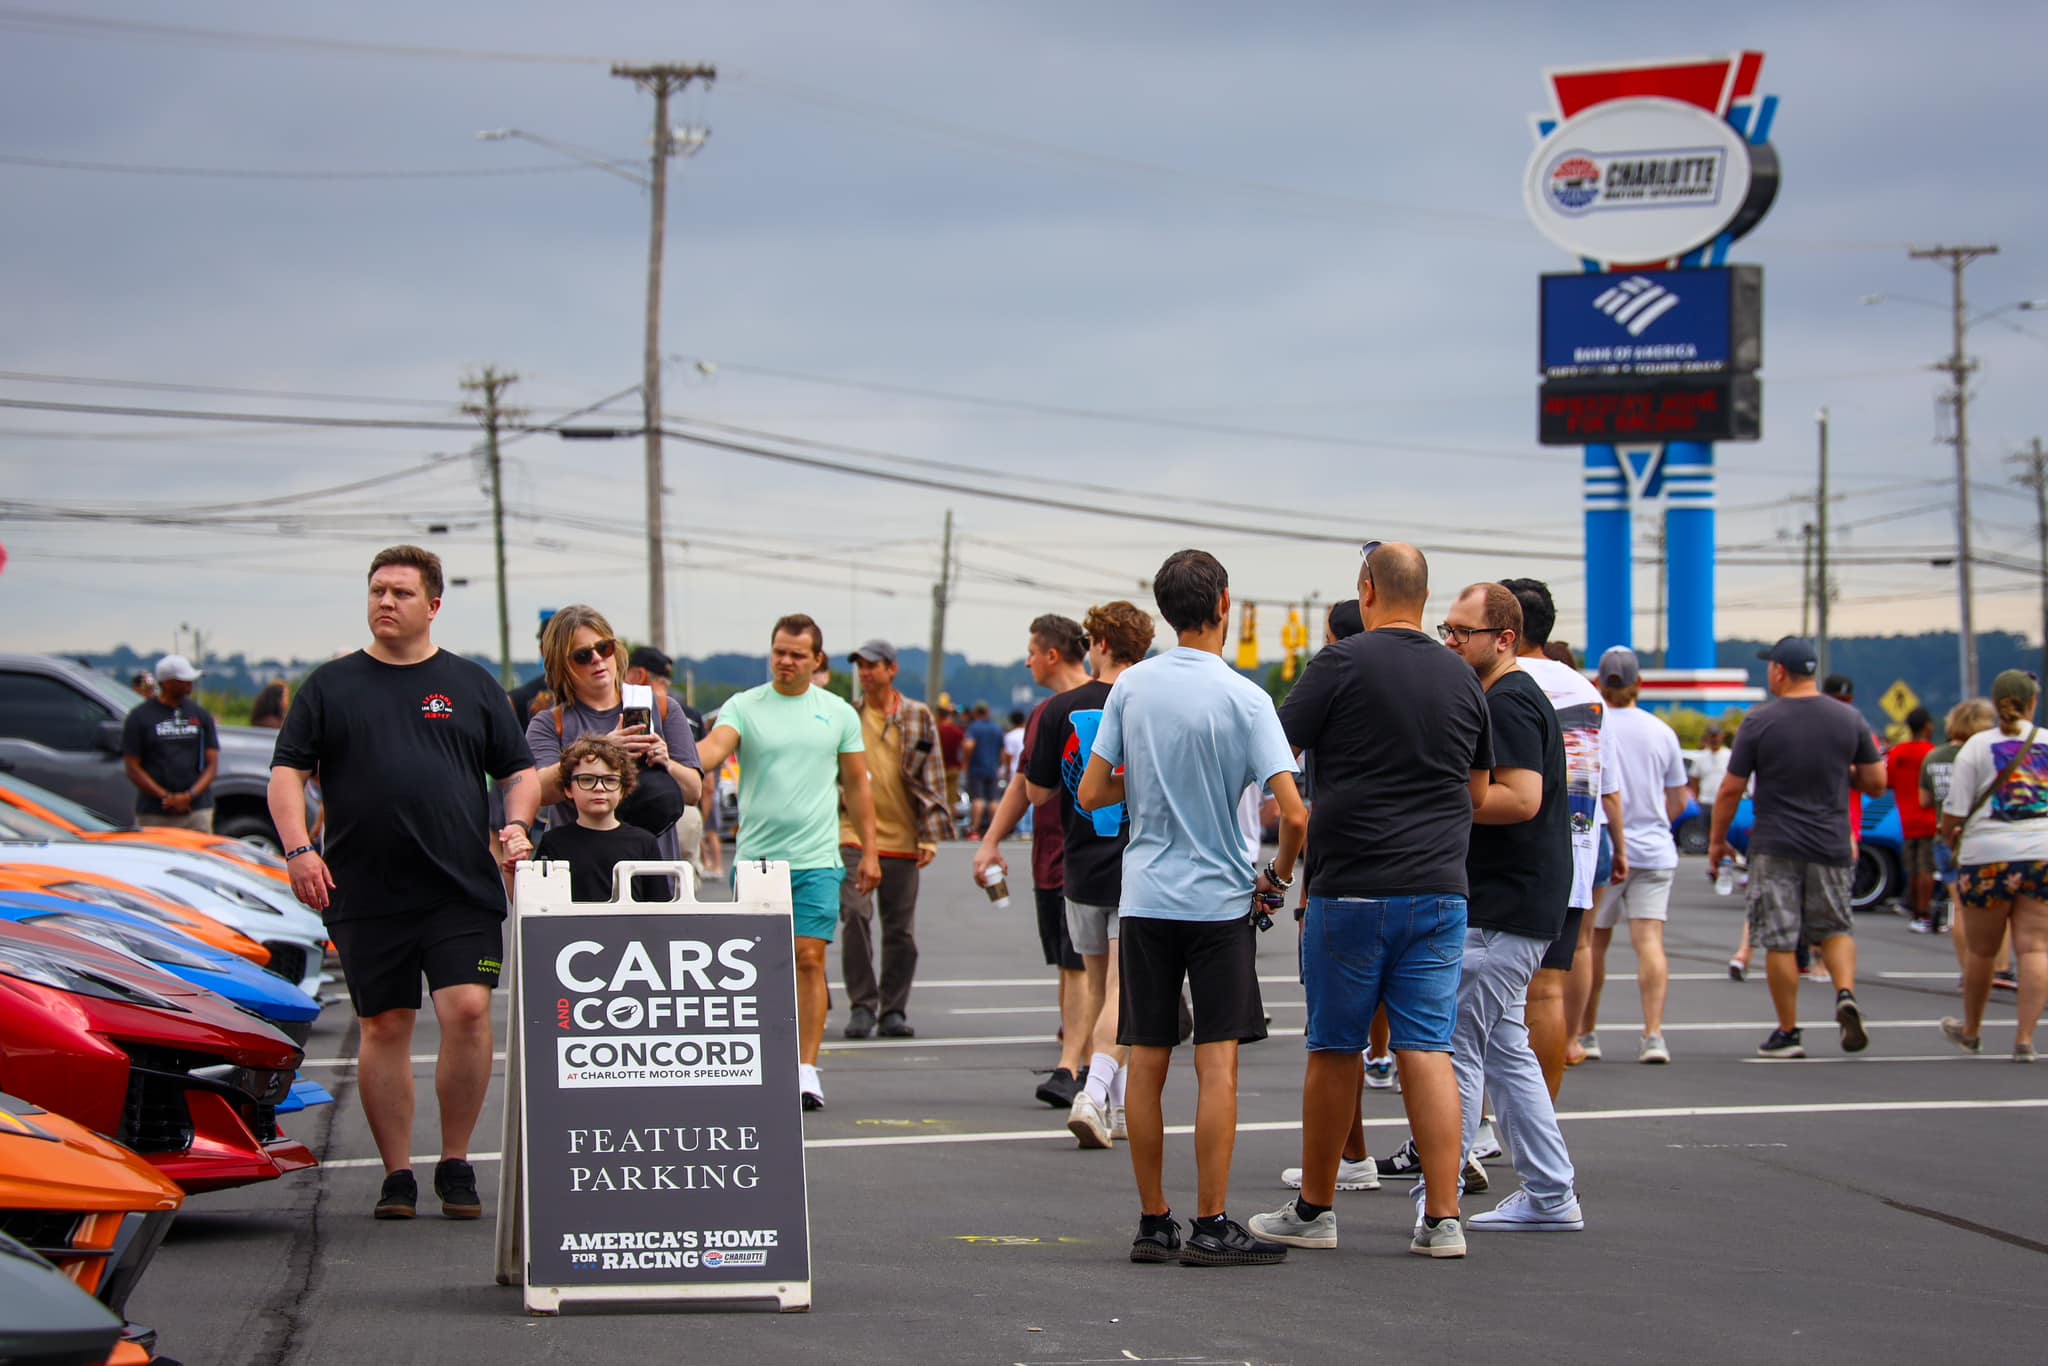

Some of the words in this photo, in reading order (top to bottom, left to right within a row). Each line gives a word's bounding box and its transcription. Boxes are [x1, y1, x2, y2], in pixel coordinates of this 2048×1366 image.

[1605, 156, 1716, 188] CHARLOTTE
[555, 938, 758, 993] CARS
[557, 998, 571, 1030] AND
[573, 996, 759, 1030] COFFEE
[565, 1041, 754, 1068] CONCORD
[567, 1073, 578, 1081] AT
[580, 1070, 646, 1080] CHARLOTTE
[649, 1069, 691, 1079] MOTOR
[694, 1068, 754, 1079] SPEEDWAY
[567, 1126, 760, 1154] FEATURE
[569, 1164, 761, 1192] PARKING
[560, 1230, 699, 1250] AMERICA'S
[703, 1229, 778, 1248] HOME
[571, 1253, 598, 1263] FOR
[602, 1250, 700, 1270] RACING
[724, 1252, 764, 1261] CHARLOTTE
